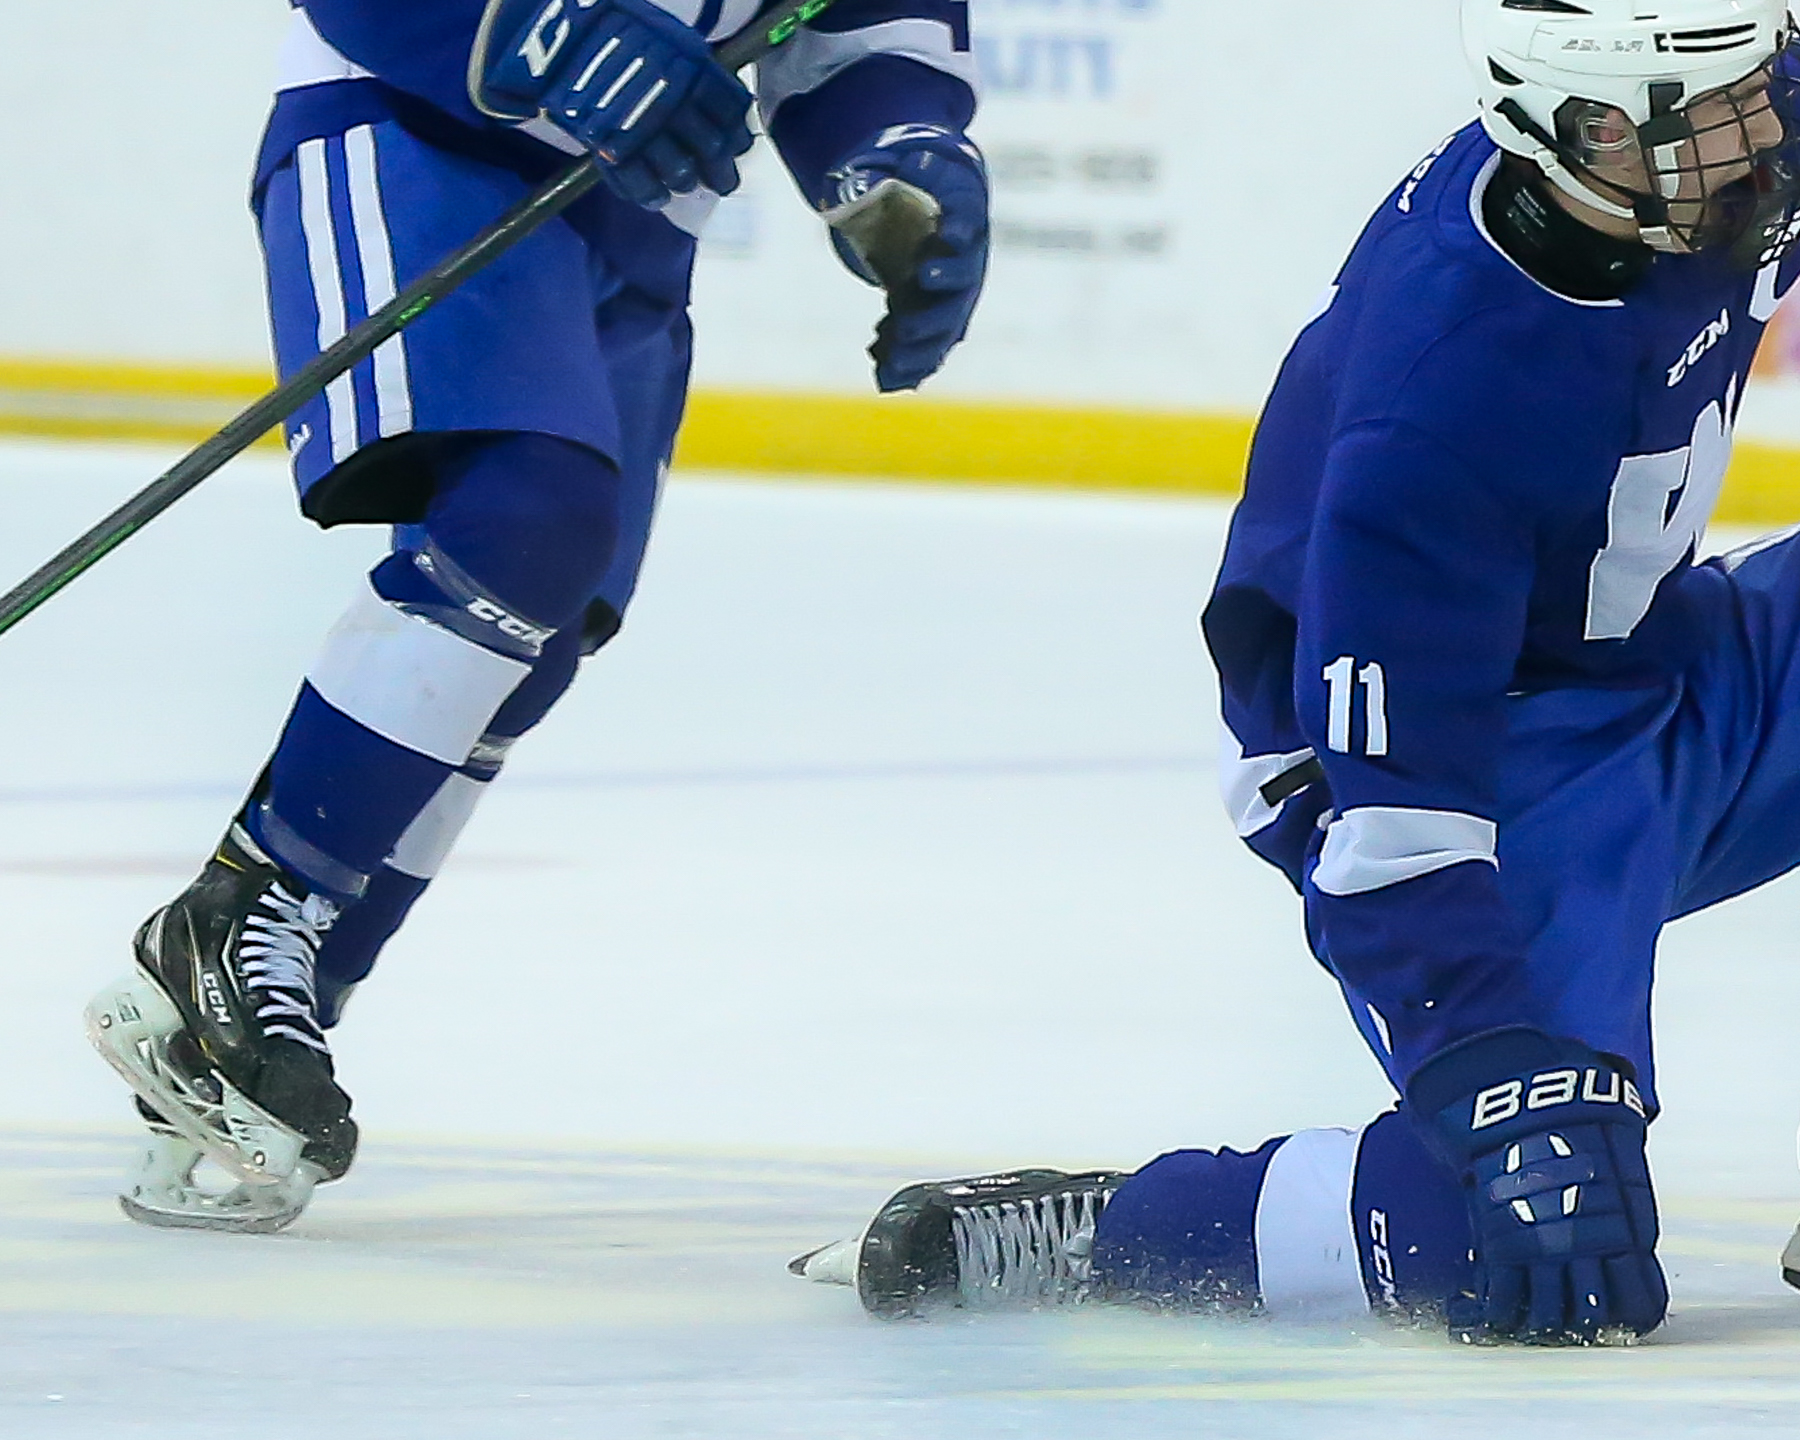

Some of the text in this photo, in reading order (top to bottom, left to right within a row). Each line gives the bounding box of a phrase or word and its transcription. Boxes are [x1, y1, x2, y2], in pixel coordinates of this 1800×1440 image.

[1667, 308, 1730, 388] CCM
[1323, 656, 1388, 756] 11
[202, 972, 231, 1024] CCM
